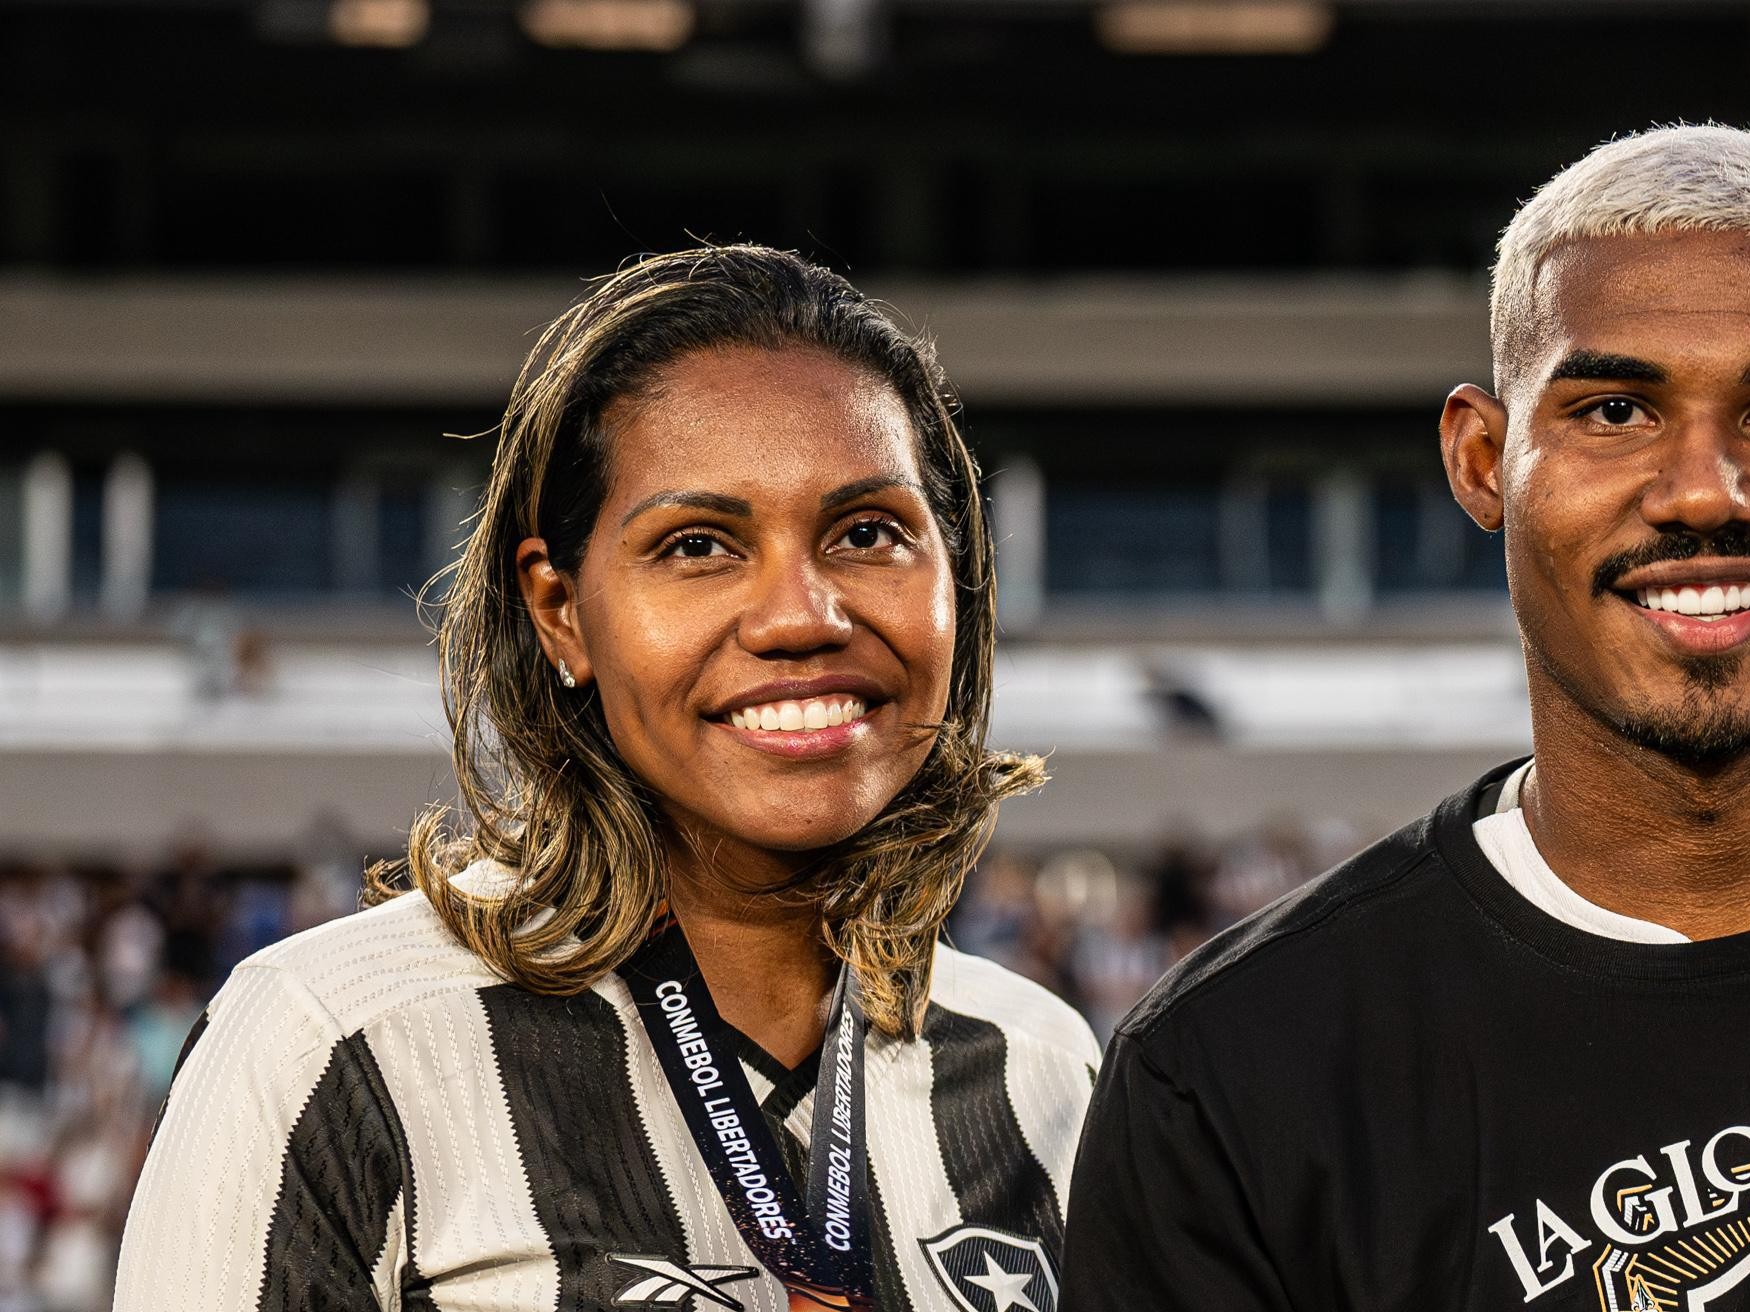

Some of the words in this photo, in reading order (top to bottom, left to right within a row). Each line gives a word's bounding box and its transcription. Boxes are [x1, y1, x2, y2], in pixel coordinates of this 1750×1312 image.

[655, 980, 719, 1097] CONMEBOL
[704, 1085, 793, 1241] LIBERTADORES
[831, 1003, 855, 1145] LIBERTADORES
[824, 1143, 851, 1252] CONMEBOL
[1488, 1198, 1592, 1304] LA
